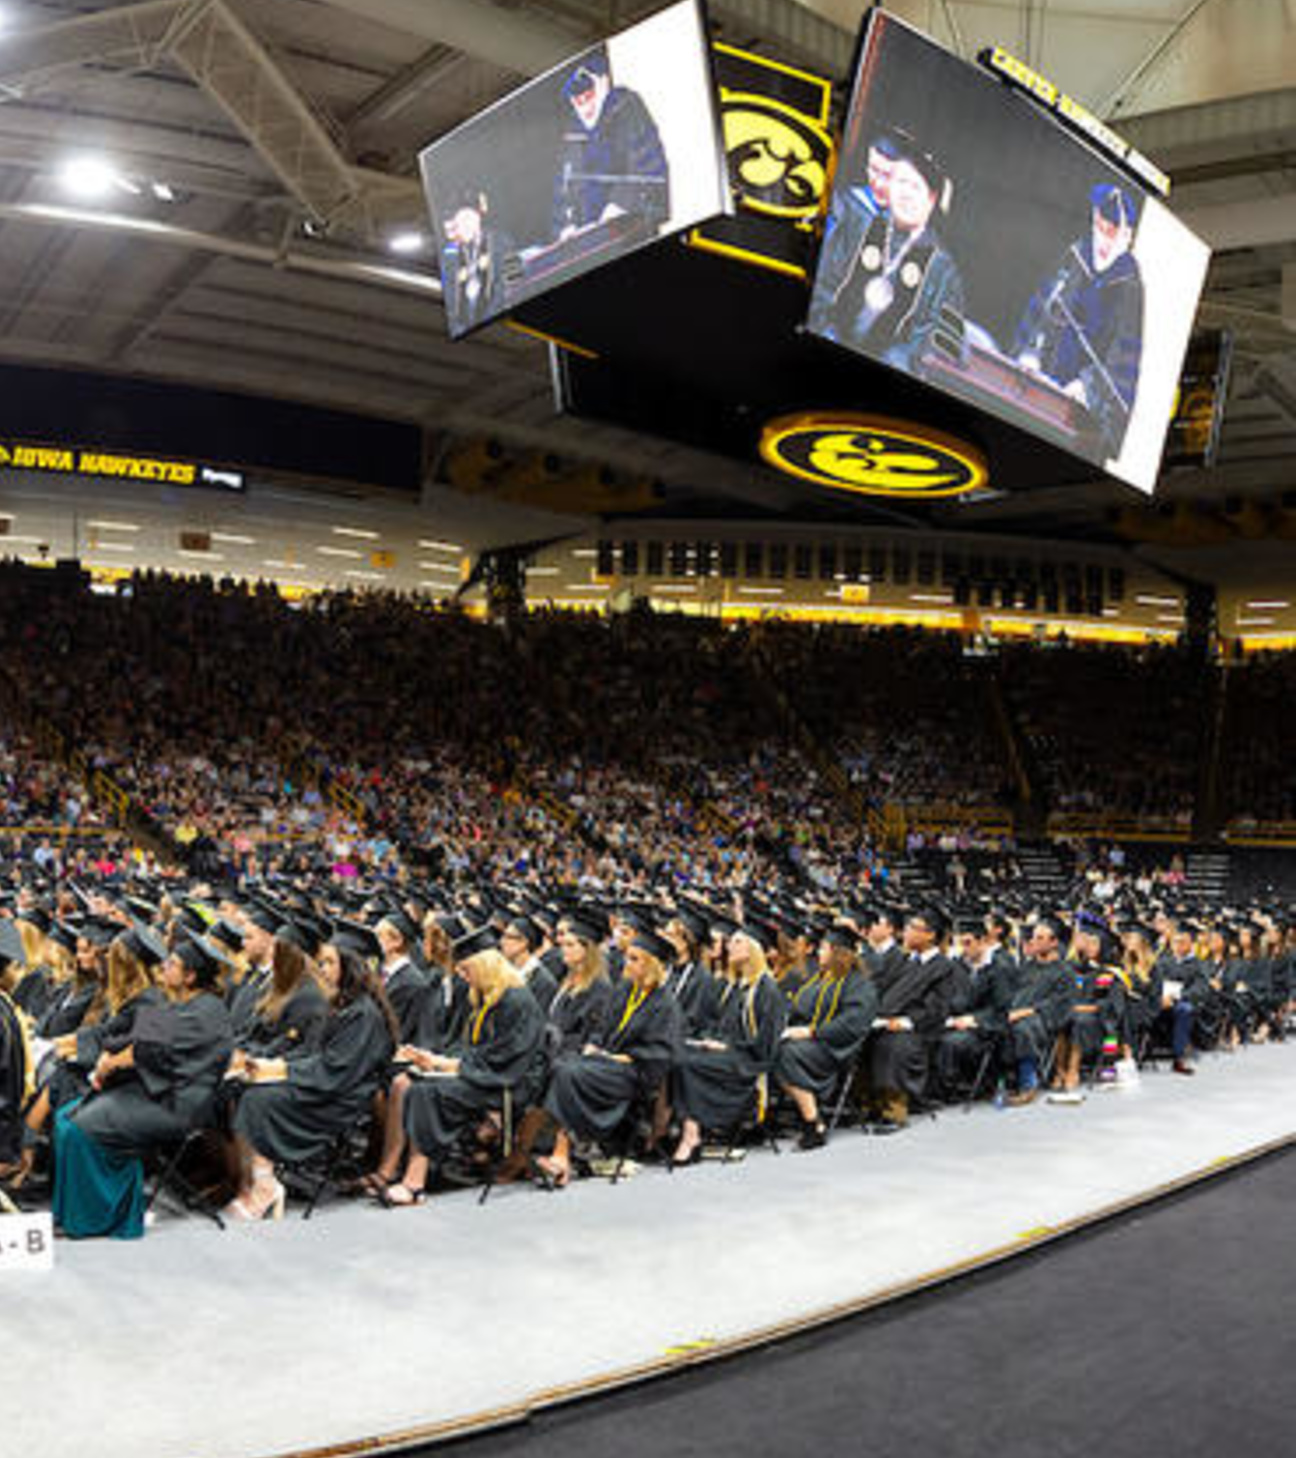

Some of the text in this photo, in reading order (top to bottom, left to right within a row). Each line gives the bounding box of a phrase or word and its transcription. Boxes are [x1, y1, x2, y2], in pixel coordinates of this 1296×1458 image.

[10, 445, 74, 471] IOWA
[78, 452, 196, 485] HAWKEYES
[26, 1229, 46, 1255] B
